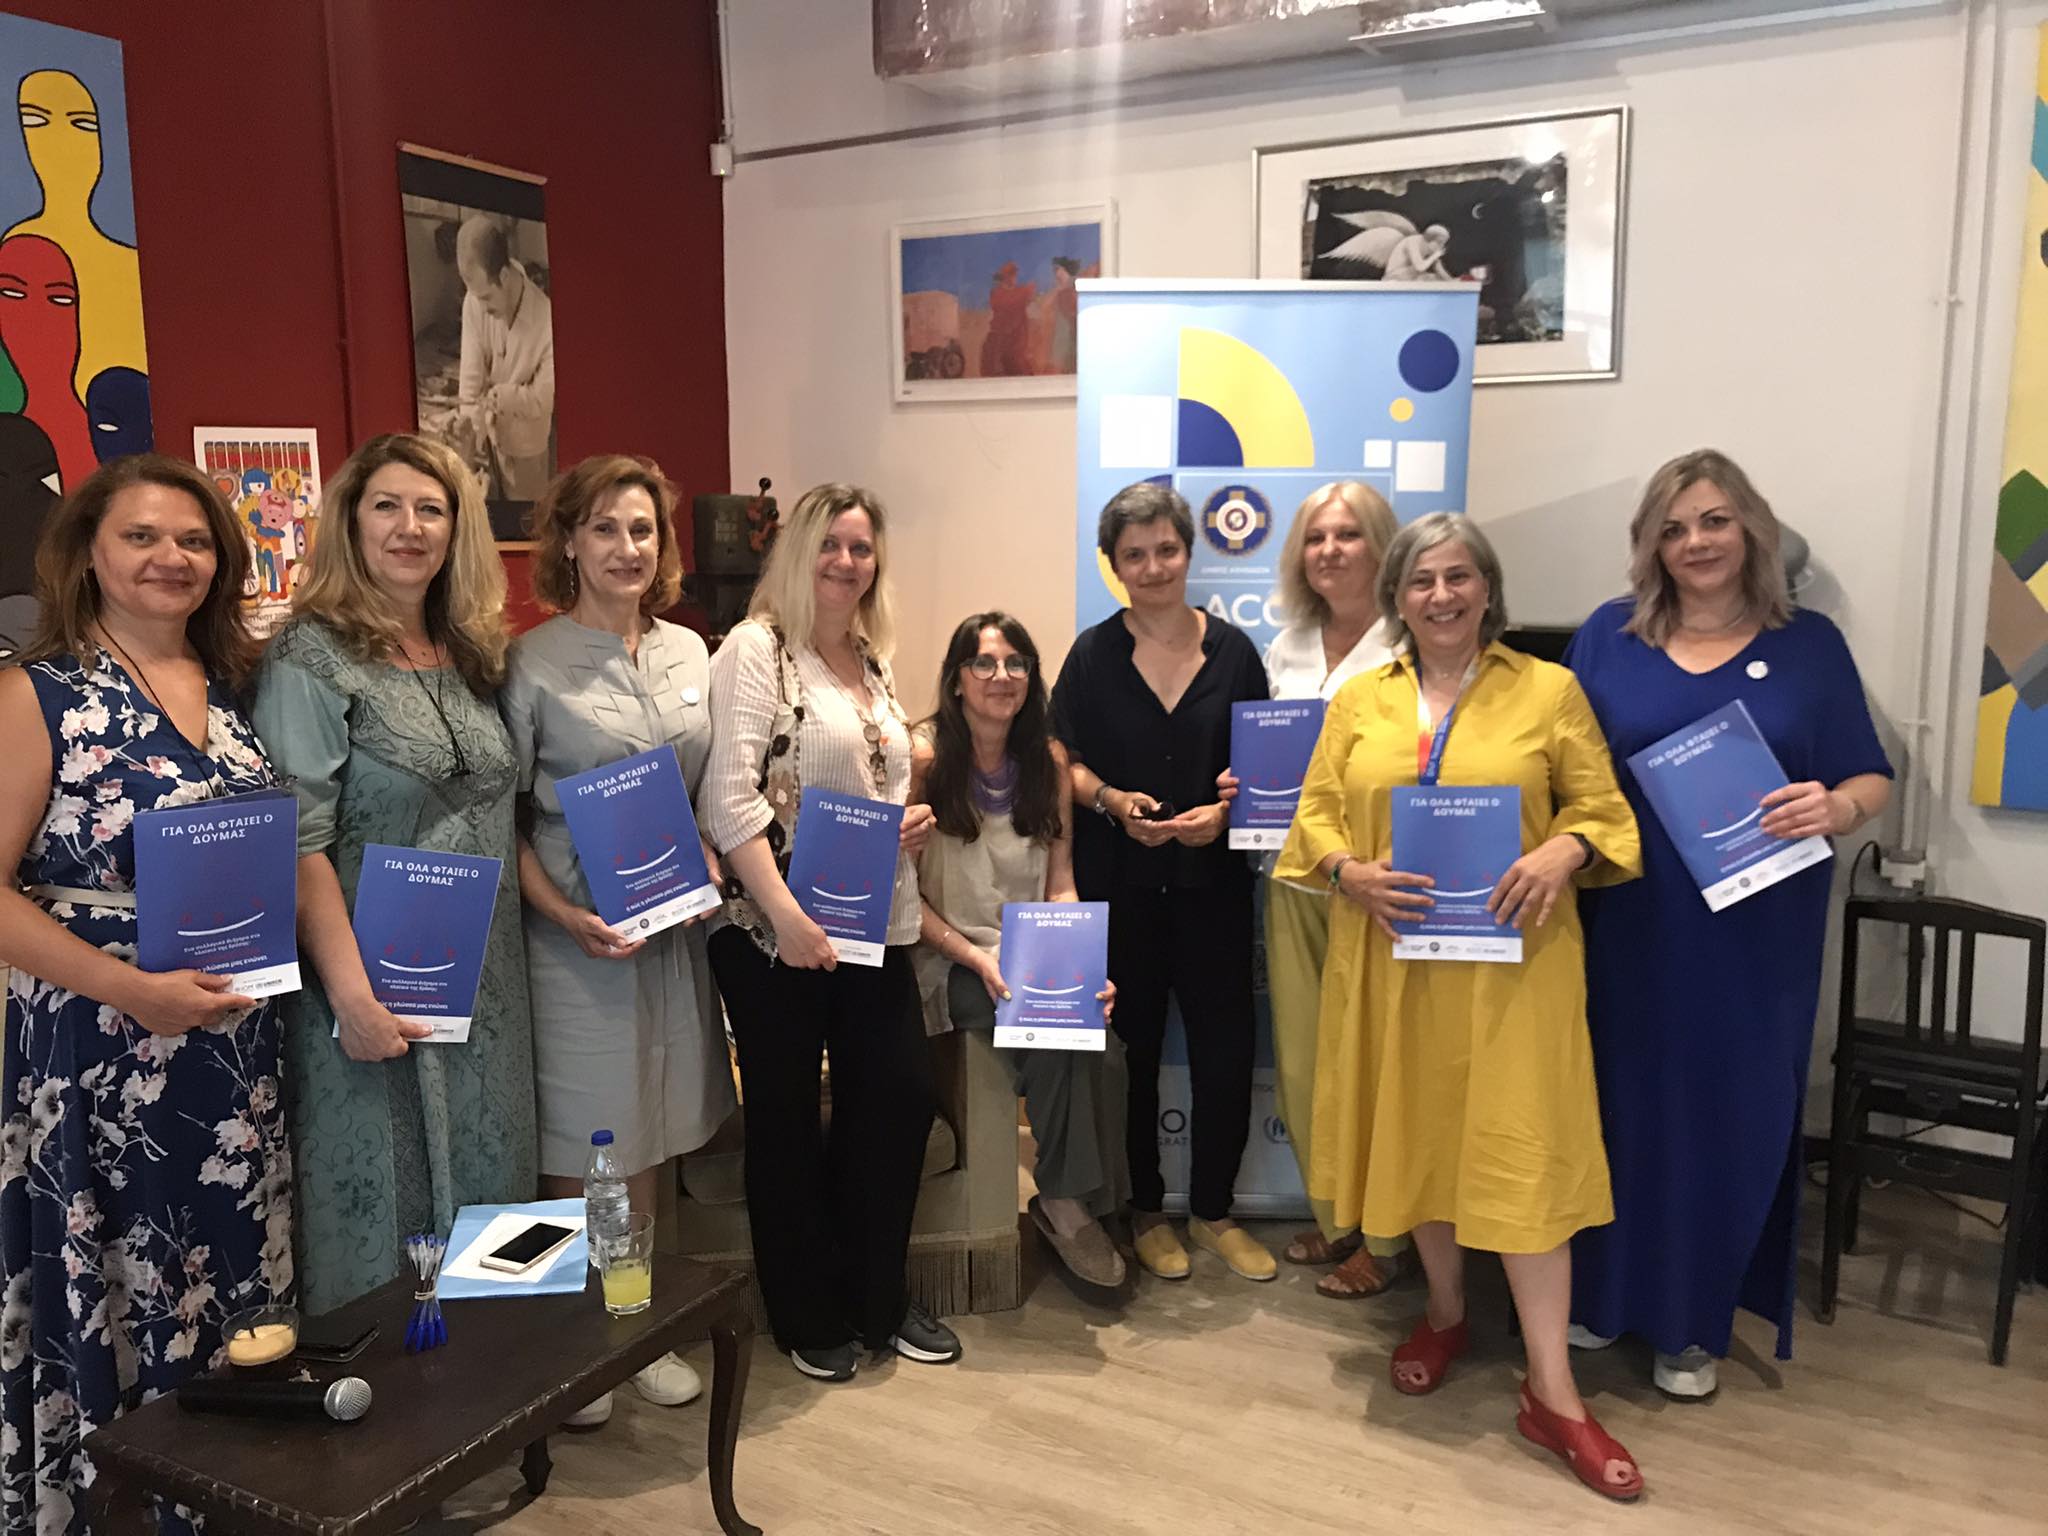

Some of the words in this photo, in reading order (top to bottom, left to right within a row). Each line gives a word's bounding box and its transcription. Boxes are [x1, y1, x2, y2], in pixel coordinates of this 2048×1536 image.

[578, 785, 595, 796] ΓΙΑ
[597, 778, 617, 789] ΟΛΑ
[619, 766, 650, 782] ΦΤΑΙΕΙ
[653, 761, 659, 770] Ο
[603, 780, 643, 797] ΔΟΥΜΑΣ
[1410, 798, 1426, 806] ΓΙΑ
[1429, 798, 1450, 806] ΟΛΑ
[1454, 798, 1489, 806] ΦΤΑΙΕΙ
[1492, 798, 1499, 806] Ο
[819, 801, 832, 810] ΓΙΑ
[835, 804, 851, 814] ΟΛΑ
[854, 809, 880, 820] ΦΤΑΙΕΙ
[1434, 808, 1476, 816] ΔΟΥΜΑΣ
[162, 827, 184, 837] ΓΙΑ
[188, 822, 214, 833] ΟΛΑ
[218, 818, 260, 829] ΦΤΑΙΕΙ
[265, 814, 273, 823] Ο
[836, 814, 869, 826] ΔΟΥΜΑΣ
[193, 829, 246, 844] ΔΟΥΜΑΣ
[385, 860, 403, 870] ΓΙΑ
[407, 863, 429, 873] ΟΛΑ
[432, 866, 468, 877] ΦΤΑΙΕΙ
[472, 869, 479, 878] Ο
[408, 874, 454, 886] ΔΟΥΜΑΣ
